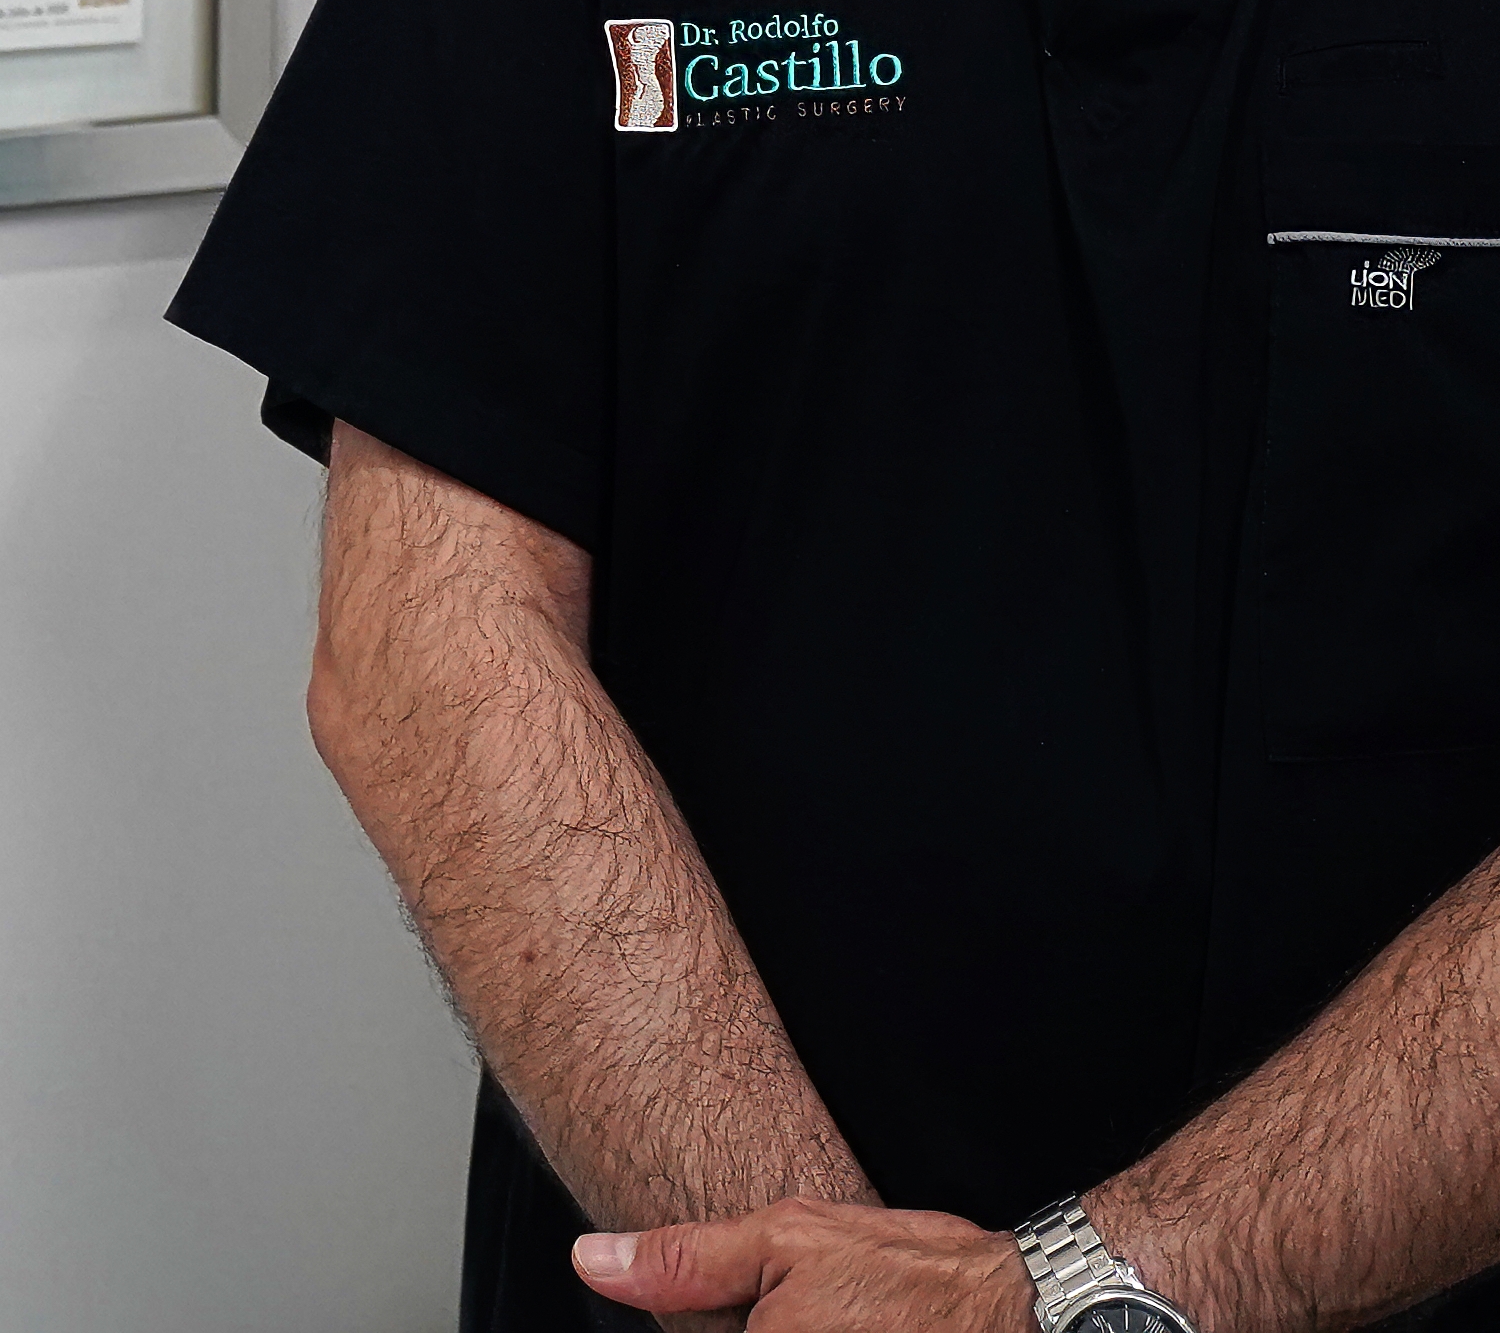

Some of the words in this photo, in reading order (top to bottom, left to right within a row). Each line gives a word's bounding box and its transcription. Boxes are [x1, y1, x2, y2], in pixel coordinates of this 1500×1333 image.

[680, 23, 719, 46] Dr.
[729, 14, 838, 44] Rodolfo
[685, 40, 902, 101] Castillo
[797, 95, 908, 118] SURGERY
